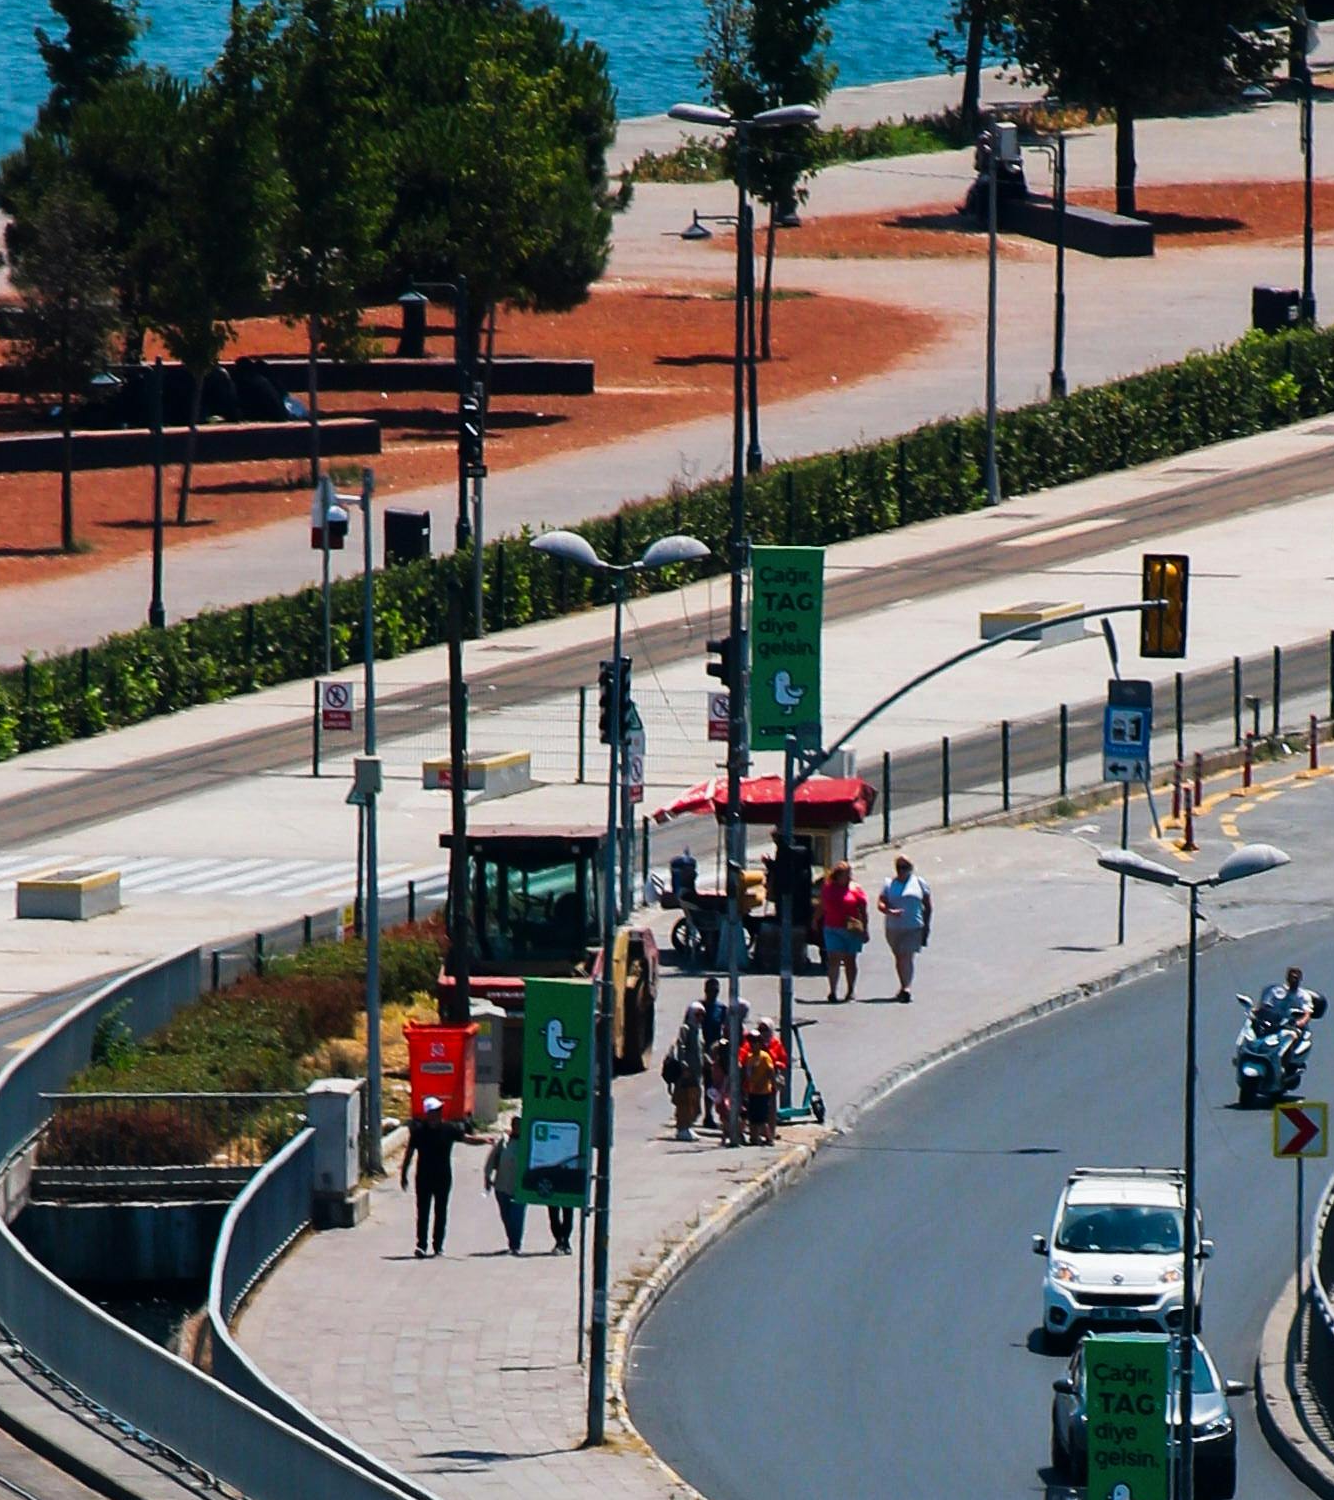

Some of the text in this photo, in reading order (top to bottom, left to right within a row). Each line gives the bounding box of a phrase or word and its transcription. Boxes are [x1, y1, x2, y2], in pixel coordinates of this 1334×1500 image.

[762, 592, 814, 612] TAG
[758, 617, 798, 636] diye
[530, 1075, 588, 1101] TAG
[1093, 1363, 1153, 1386] Çağır,
[1099, 1393, 1156, 1415] TAG
[1095, 1424, 1137, 1444] diye
[1094, 1450, 1160, 1469] gelsin.
